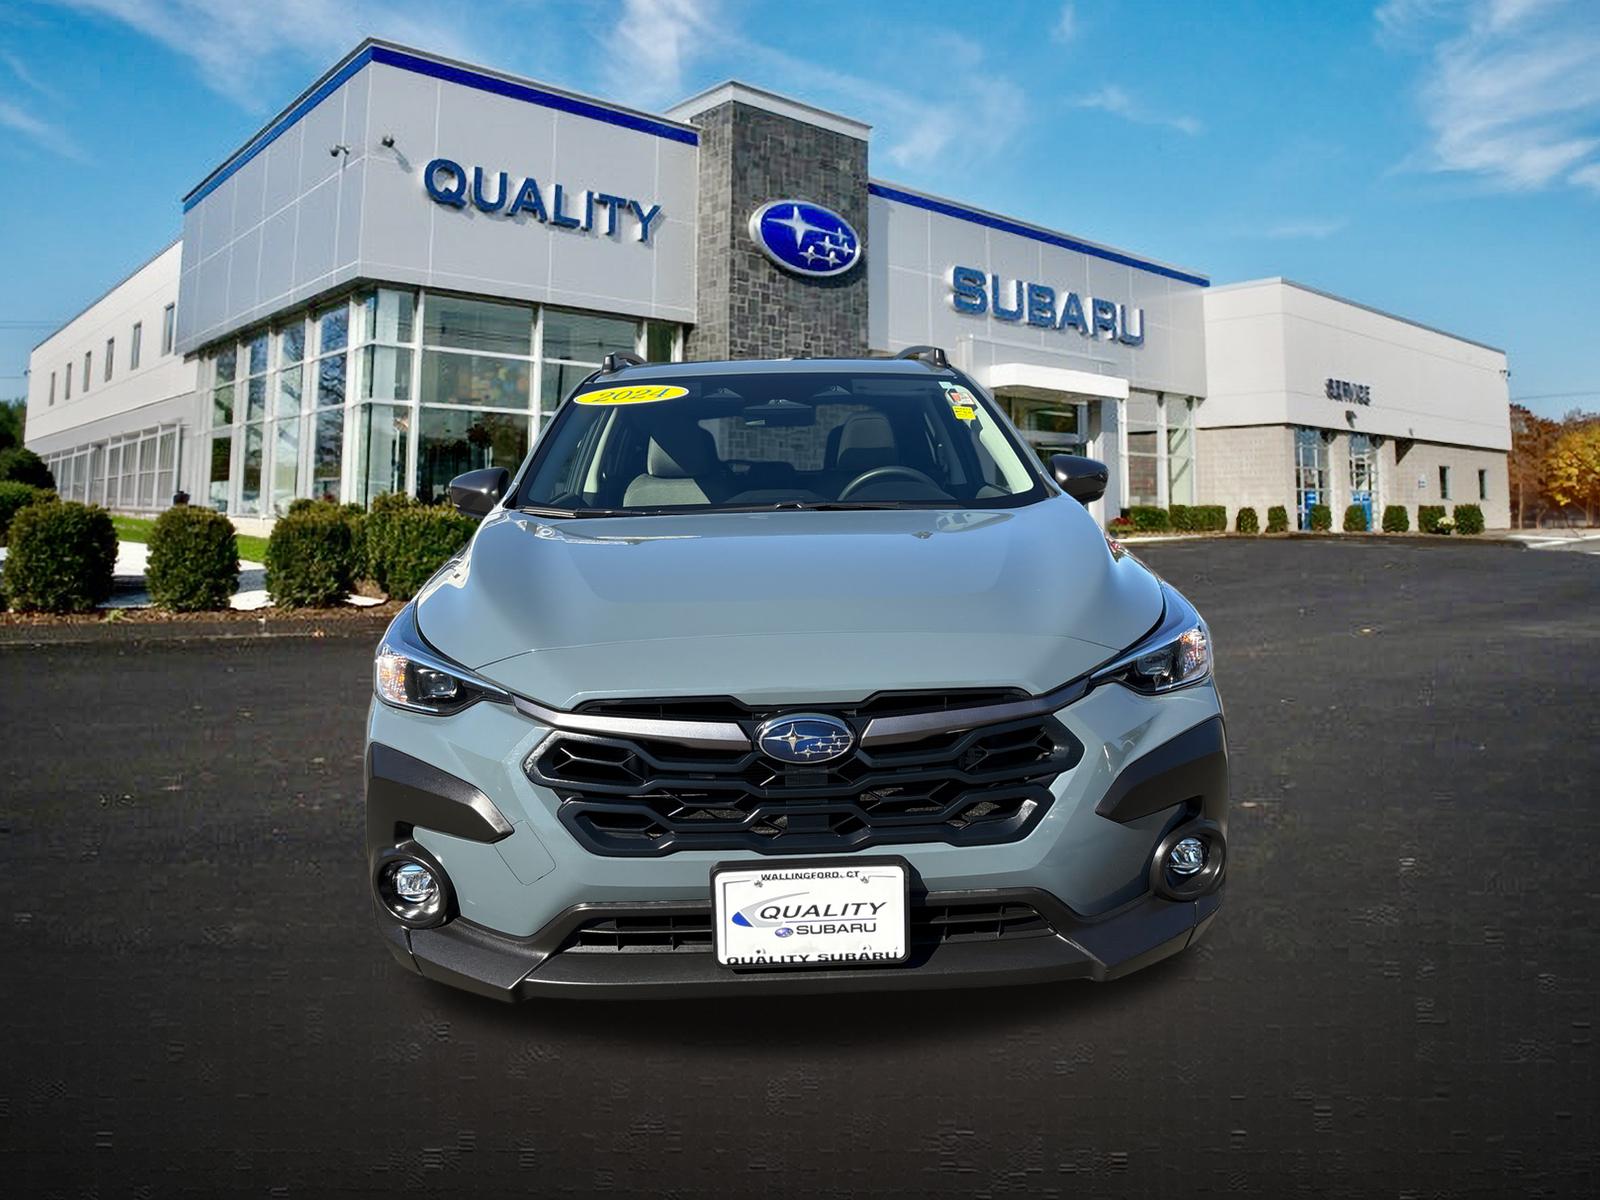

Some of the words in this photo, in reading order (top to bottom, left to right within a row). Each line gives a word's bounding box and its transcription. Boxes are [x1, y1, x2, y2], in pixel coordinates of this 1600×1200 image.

[424, 158, 662, 243] QUALITY
[952, 265, 1145, 346] SUBARU
[593, 387, 671, 402] 2024
[760, 901, 887, 920] QUALITY
[796, 922, 877, 935] SUBARU
[726, 953, 811, 965] QUALITY
[818, 951, 898, 961] SUBARU
